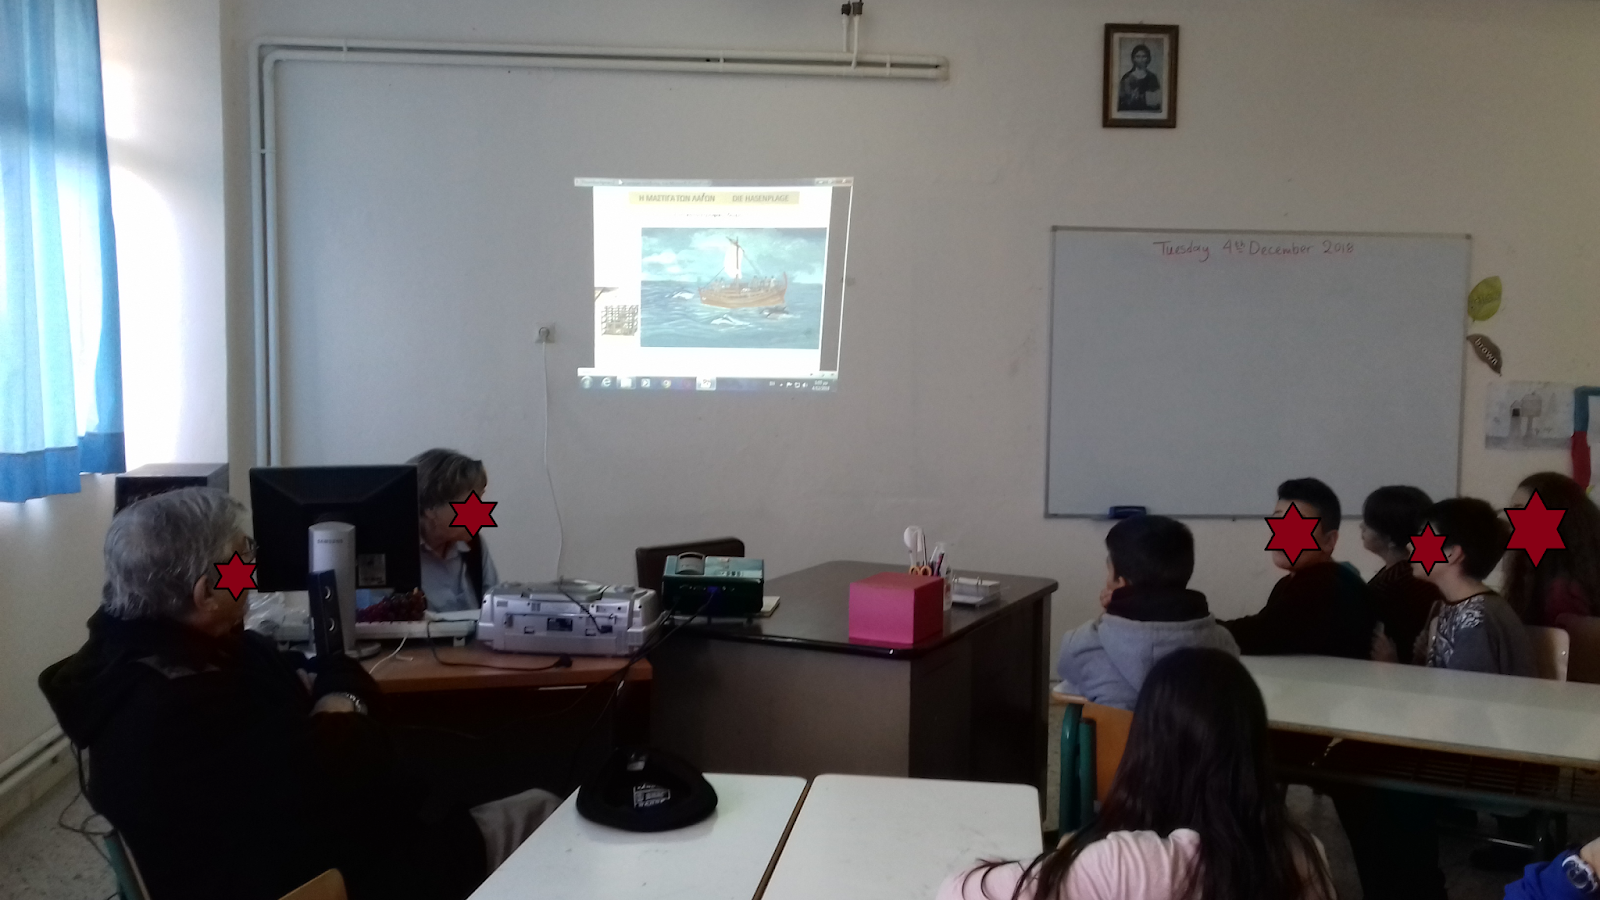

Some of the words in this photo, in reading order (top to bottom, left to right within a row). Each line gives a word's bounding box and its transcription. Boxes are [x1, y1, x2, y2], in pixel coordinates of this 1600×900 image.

[676, 194, 690, 202] ΤΩΝ
[732, 194, 743, 202] DIE
[745, 193, 789, 202] HASENPLAGE
[1153, 240, 1210, 263] Tuesday
[1249, 240, 1314, 256] December
[1322, 239, 1355, 255] 2018
[1474, 337, 1498, 366] brown
